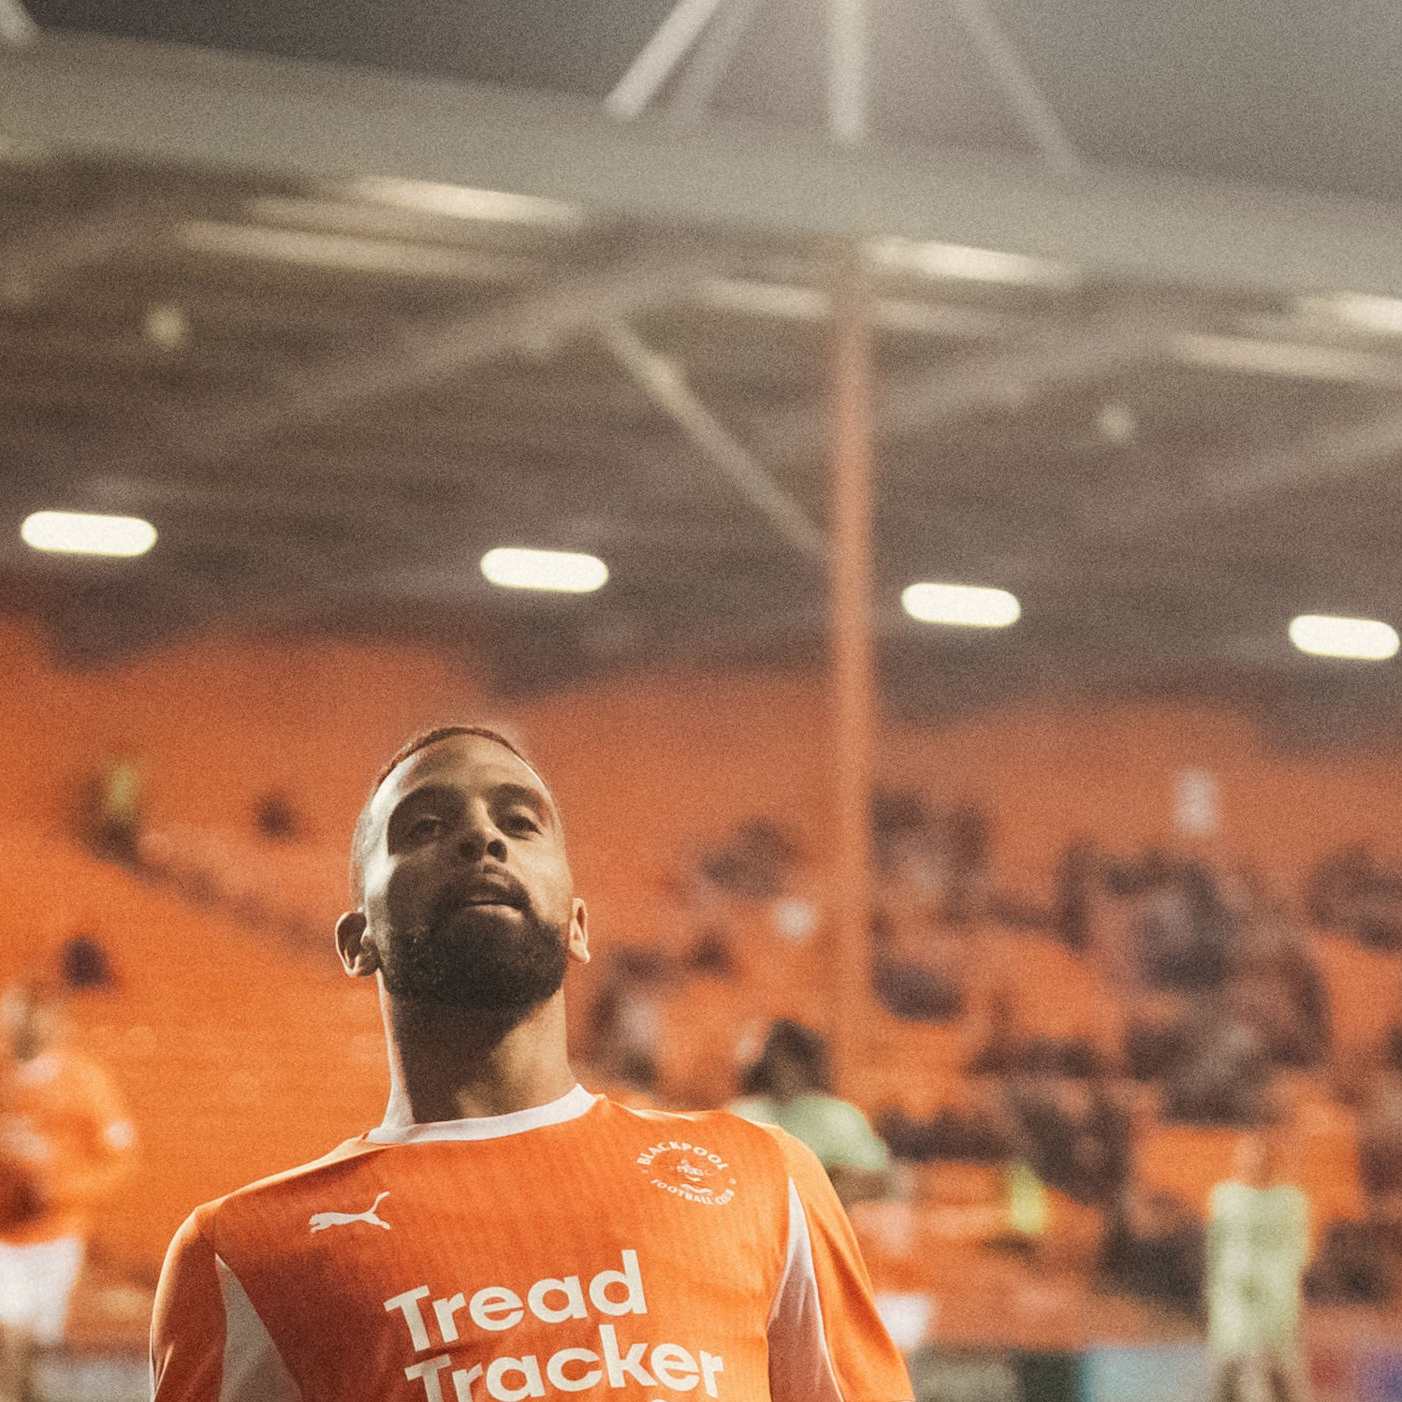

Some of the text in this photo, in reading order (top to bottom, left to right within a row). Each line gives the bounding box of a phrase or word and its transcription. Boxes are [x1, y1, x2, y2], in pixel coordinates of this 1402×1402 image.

[637, 1141, 728, 1170] BLACKPOOL
[650, 1179, 713, 1205] FOOTBALL
[383, 1249, 648, 1352] Tread
